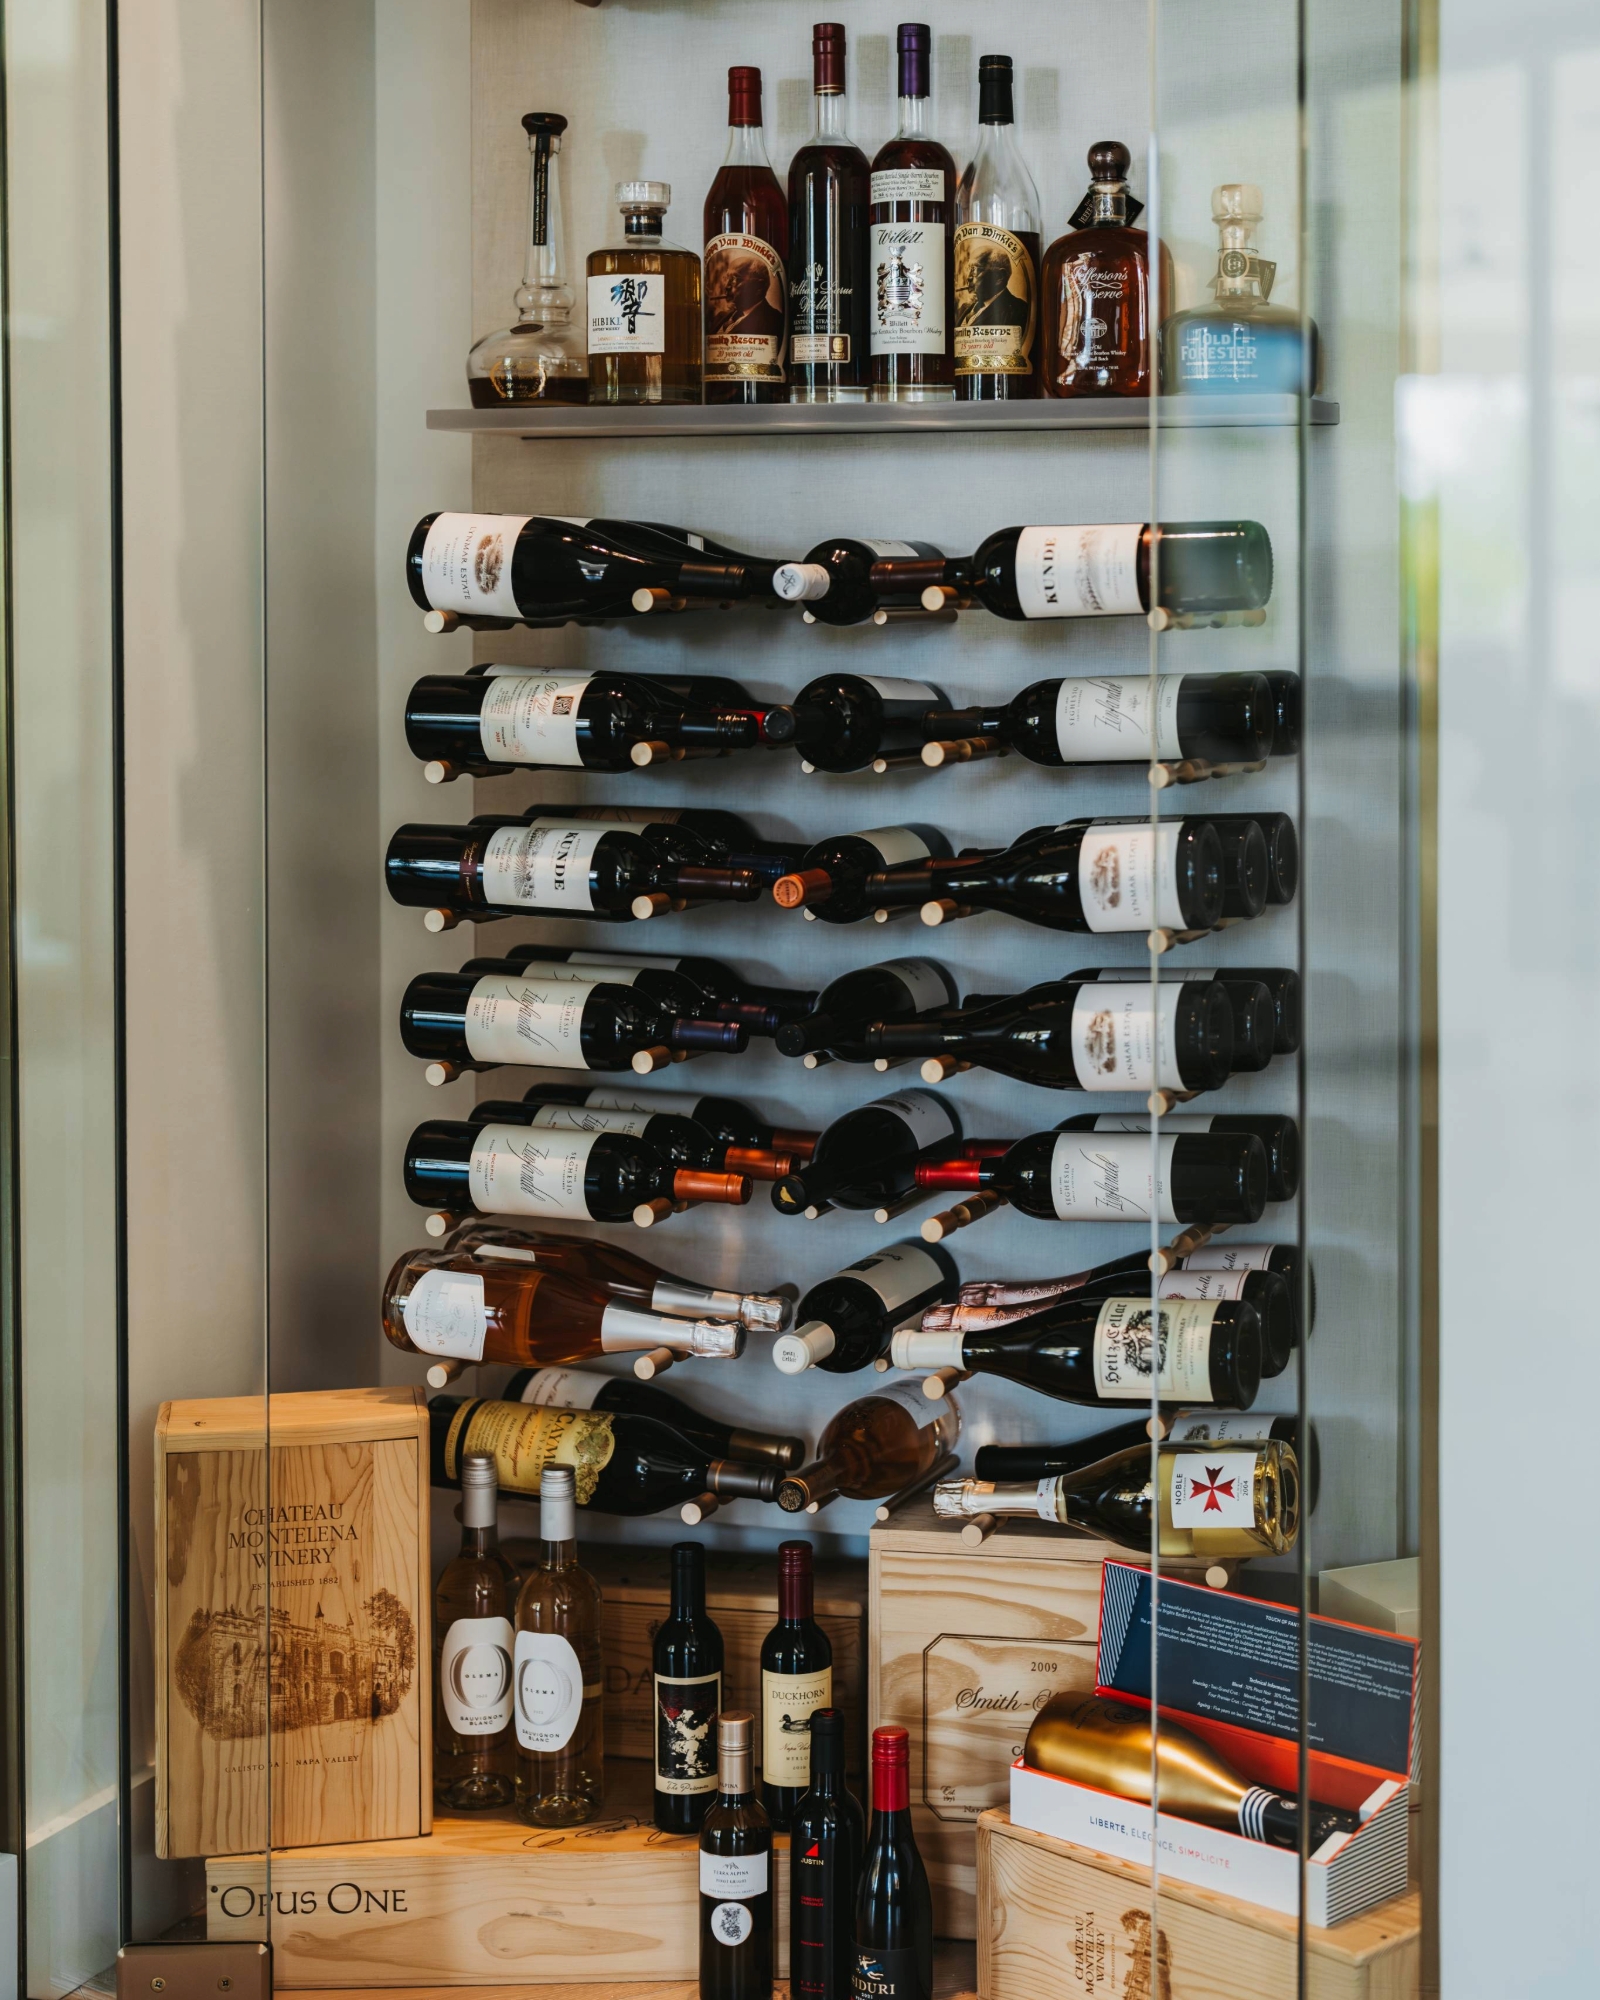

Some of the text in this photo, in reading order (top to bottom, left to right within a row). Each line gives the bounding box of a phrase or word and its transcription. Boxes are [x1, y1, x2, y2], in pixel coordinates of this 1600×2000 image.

[719, 238, 737, 248] Van
[962, 227, 978, 237] Van
[592, 317, 621, 326] HIBIKI
[973, 327, 1011, 336] Reserve
[730, 336, 769, 345] Reserve
[1202, 333, 1231, 345] OLD
[1181, 346, 1257, 360] FORESTER
[1042, 537, 1058, 604] KUNDE
[460, 568, 471, 600] ESTATE
[1069, 686, 1079, 726] SEGHESIO
[555, 832, 579, 891] KUNDE
[1129, 837, 1138, 870] ESTATE
[506, 985, 559, 1052] Zinfandel
[563, 997, 575, 1037] SEGHESIO
[1123, 1000, 1133, 1037] ESTATE
[506, 1138, 564, 1207] Zinfandel
[567, 1152, 577, 1194] SEGHESIO
[1079, 1148, 1147, 1214] Zinfandel
[1106, 1303, 1127, 1339] Cellar
[1217, 1420, 1229, 1441] STATE
[502, 1435, 511, 1459] VALLEY
[535, 1414, 556, 1477] VINEYARDS
[1175, 1473, 1183, 1505] NOBLE
[244, 1501, 344, 1528] CHATEAU
[228, 1524, 359, 1551] MONTELENA
[252, 1546, 337, 1570] WINERY
[318, 1576, 339, 1586] 1882
[465, 1671, 499, 1679] OLEMA
[1031, 1661, 1058, 1673] 2009
[525, 1687, 555, 1695] OLEMA
[772, 1688, 825, 1700] DUCKHORN
[460, 1713, 504, 1722] SAUVIGNON
[522, 1729, 560, 1739] SAUVIGNON
[528, 1735, 550, 1743] BLANC
[295, 1757, 321, 1767] NAPA
[324, 1754, 360, 1765] VALLEY
[800, 1857, 824, 1866] JUSTIN
[220, 1882, 408, 1918] OPUS ONE
[1075, 1915, 1084, 1980] CHATEAU
[1086, 1911, 1094, 1995] MONTELENA
[1096, 1928, 1104, 1982] WINERY
[851, 1975, 895, 1994] SIDURI
